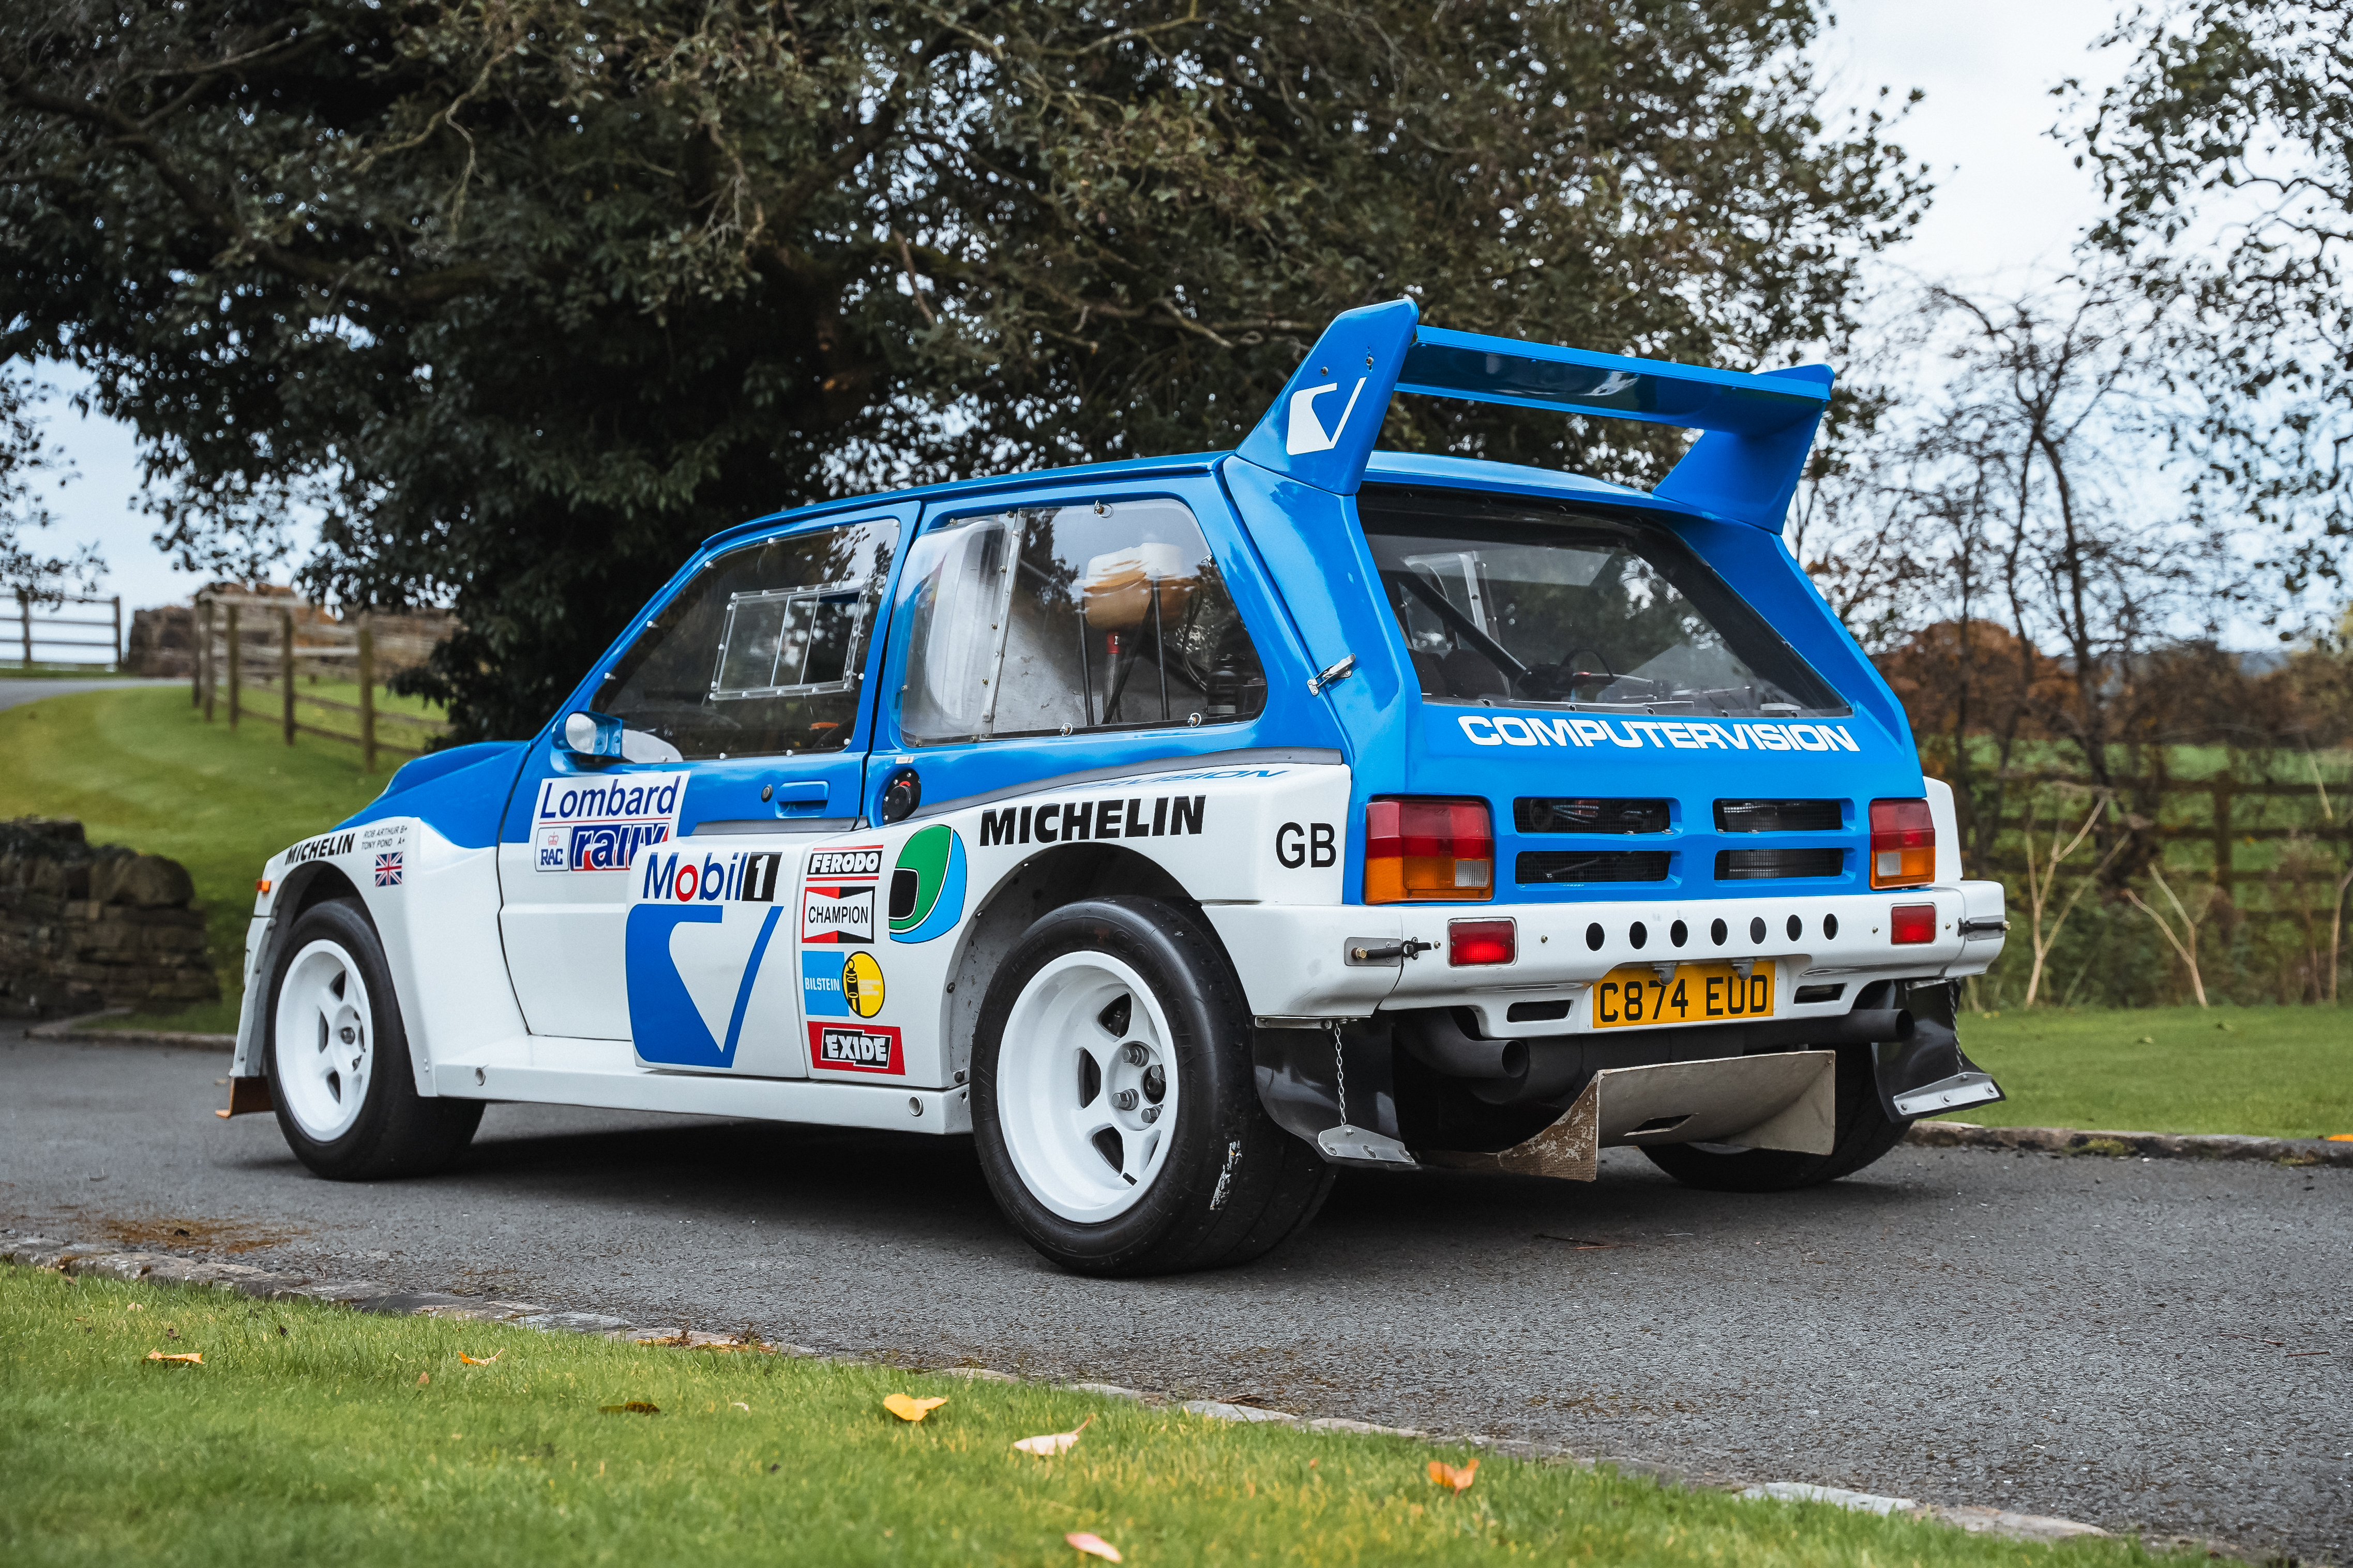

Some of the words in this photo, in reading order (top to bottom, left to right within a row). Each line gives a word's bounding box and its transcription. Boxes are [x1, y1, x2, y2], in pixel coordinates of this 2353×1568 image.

[1458, 716, 1861, 752] COMPUTERVISION
[540, 775, 681, 819] Lombard
[979, 795, 1206, 847] MICHELIN
[284, 833, 355, 866] MICHELIN
[540, 848, 563, 865] RAC
[574, 824, 669, 870] rally
[810, 852, 879, 874] FERODO
[1276, 822, 1336, 869] GB
[643, 852, 749, 902] Mobil
[755, 855, 770, 899] 1
[808, 906, 868, 924] CHAMPION
[804, 977, 840, 991] BILSTEIN
[1600, 978, 1688, 1023] C874
[1706, 975, 1768, 1016] EUD
[825, 1034, 888, 1061] EXIDE
